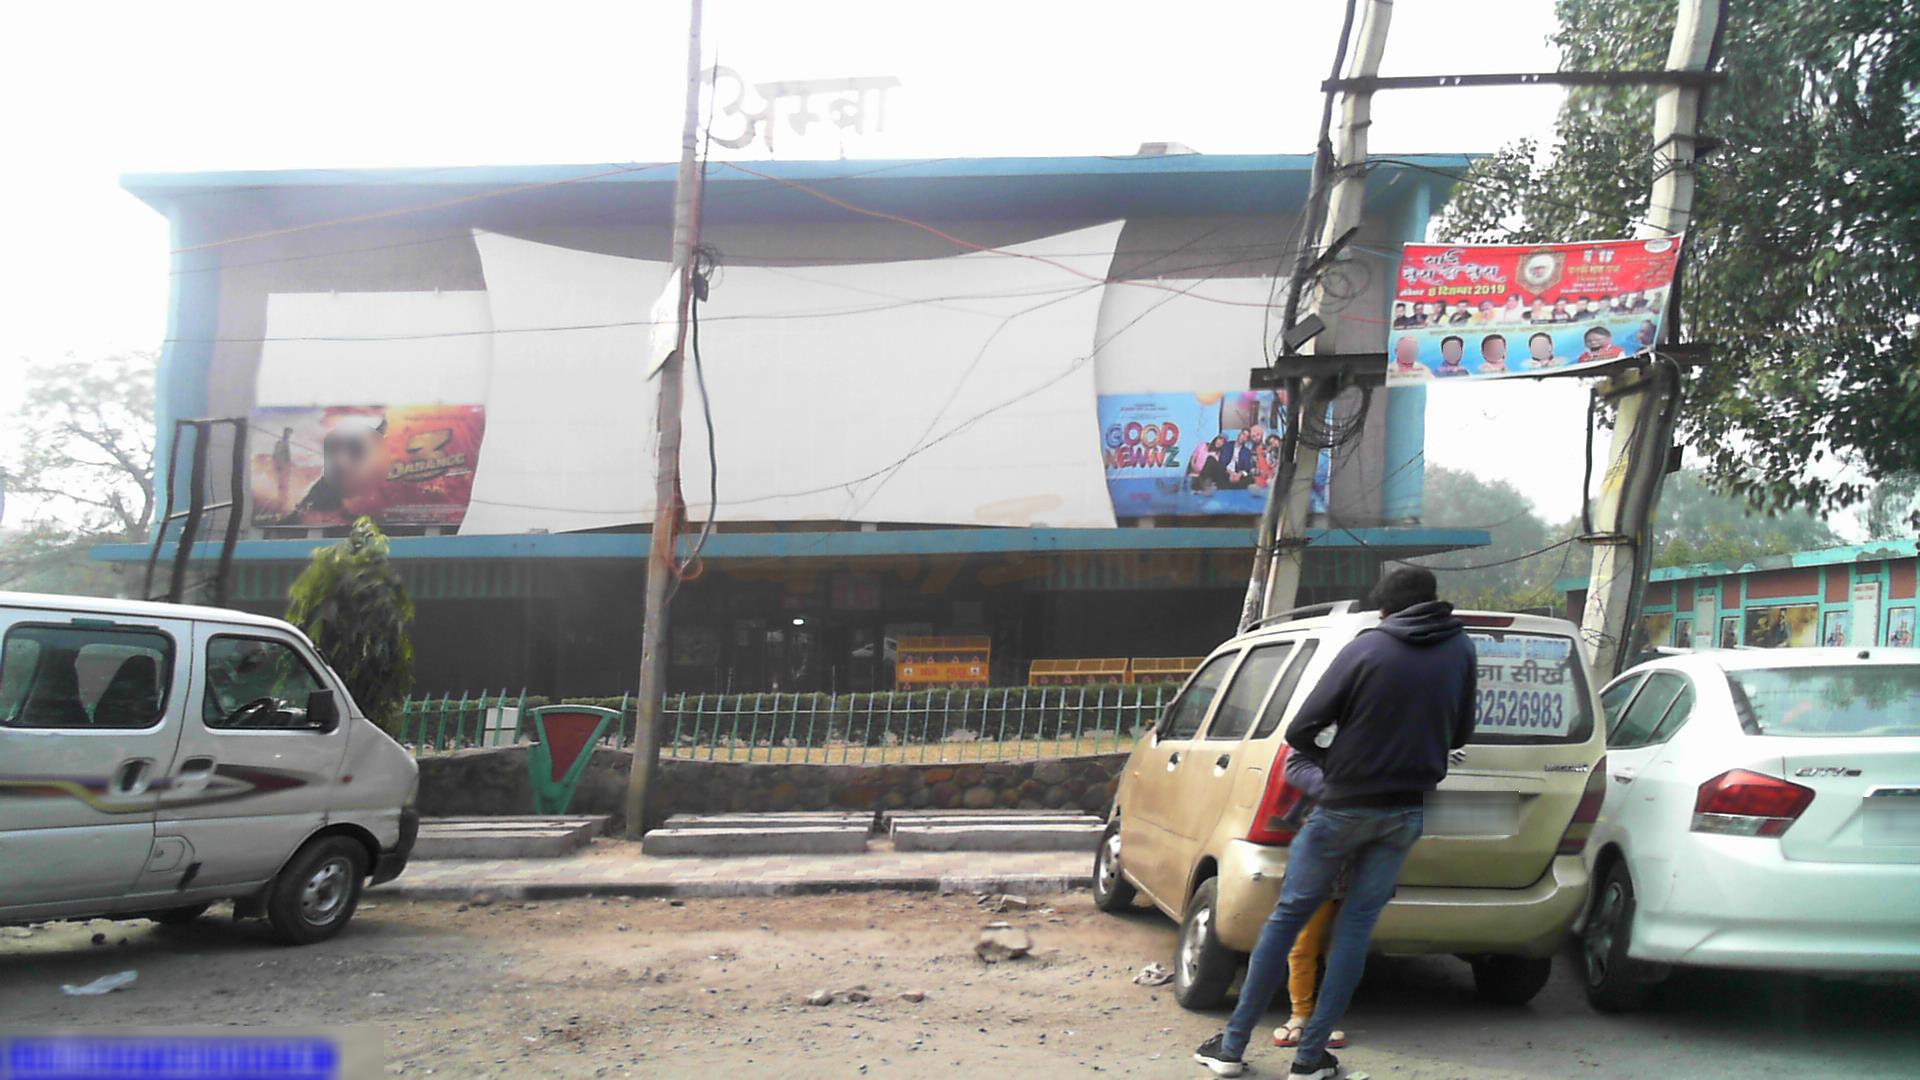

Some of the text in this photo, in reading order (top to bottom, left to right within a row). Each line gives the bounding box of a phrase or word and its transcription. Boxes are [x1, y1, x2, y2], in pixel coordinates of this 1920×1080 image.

[1474, 284, 1506, 295] 2019
[1105, 422, 1179, 449] GOOD
[1104, 446, 1180, 469] NEWWZ
[1509, 660, 1565, 685] सीखें
[1795, 767, 1846, 777] CITY
